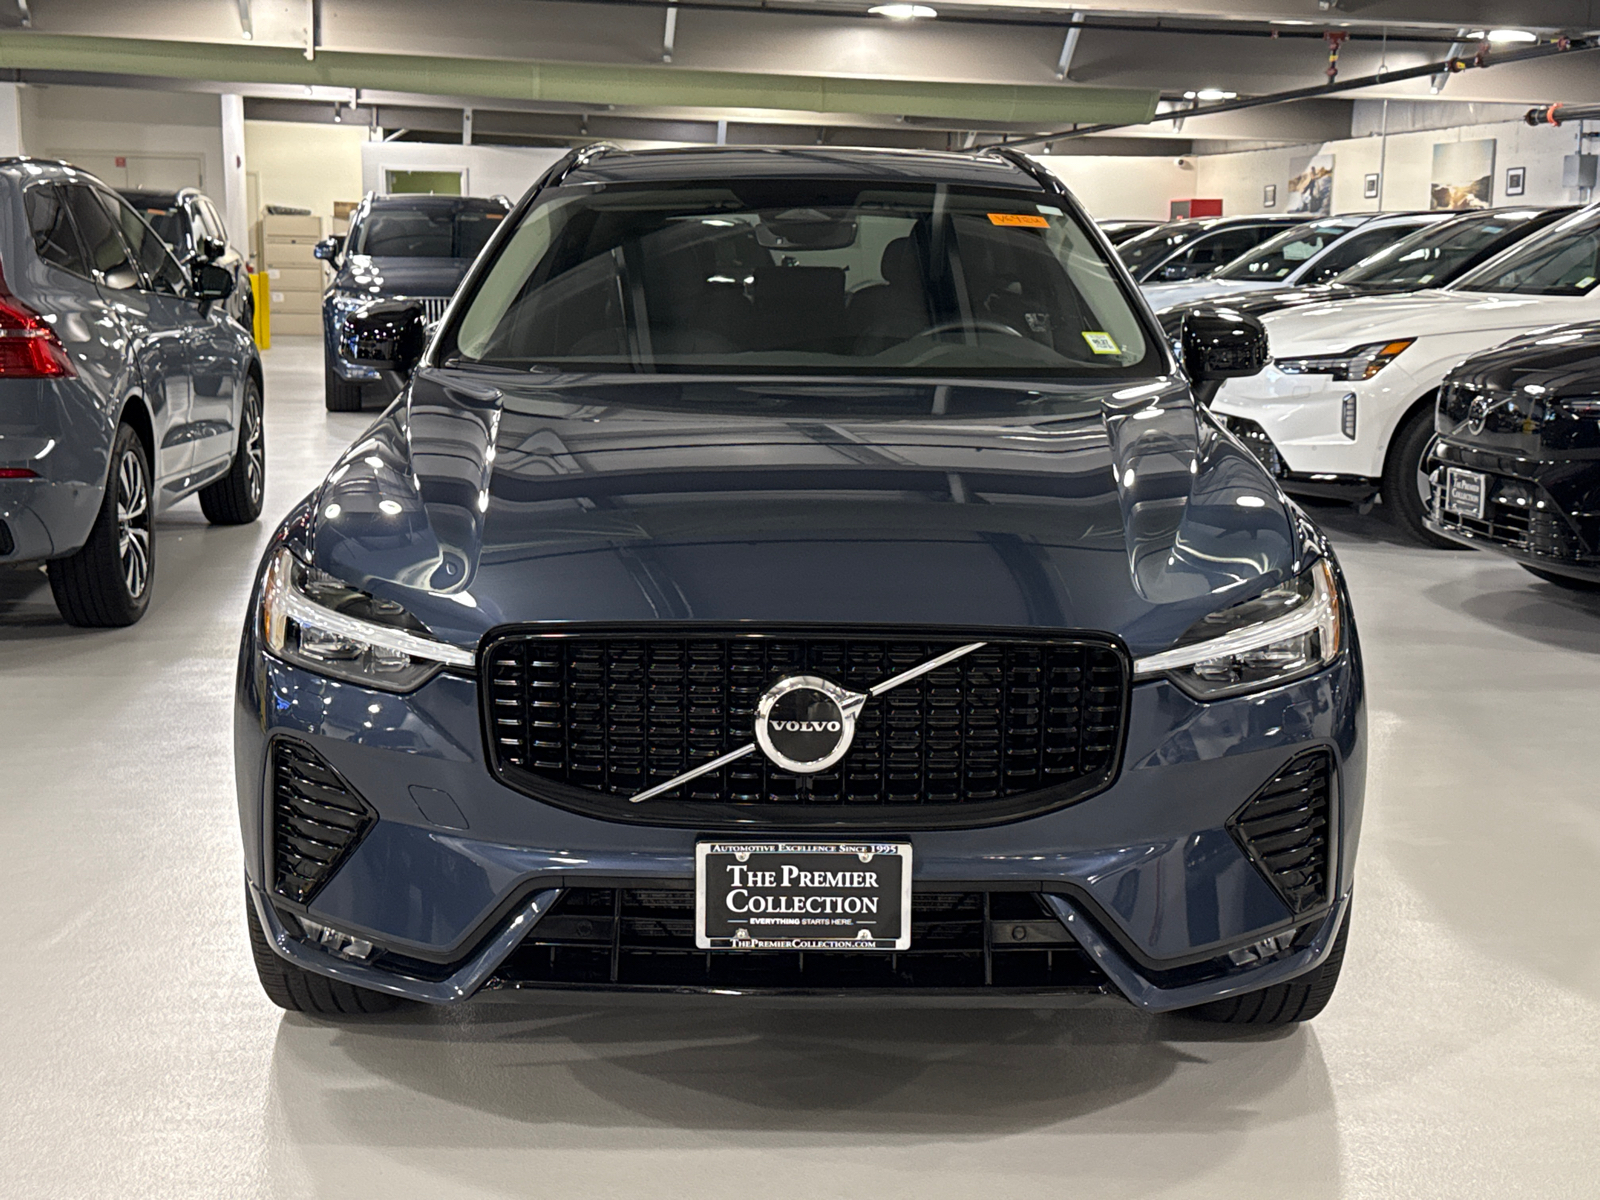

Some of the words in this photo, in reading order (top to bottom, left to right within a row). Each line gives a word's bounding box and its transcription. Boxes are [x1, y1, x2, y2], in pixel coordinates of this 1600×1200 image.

[769, 720, 841, 732] VOLVO
[713, 844, 776, 853] AUTOMOTIVE
[870, 845, 898, 854] 1995
[726, 865, 777, 888] THE
[781, 865, 879, 888] PREMIER
[726, 889, 879, 914] COLLECTION
[749, 917, 800, 926] EVERYTHING
[801, 918, 830, 926] STARTS
